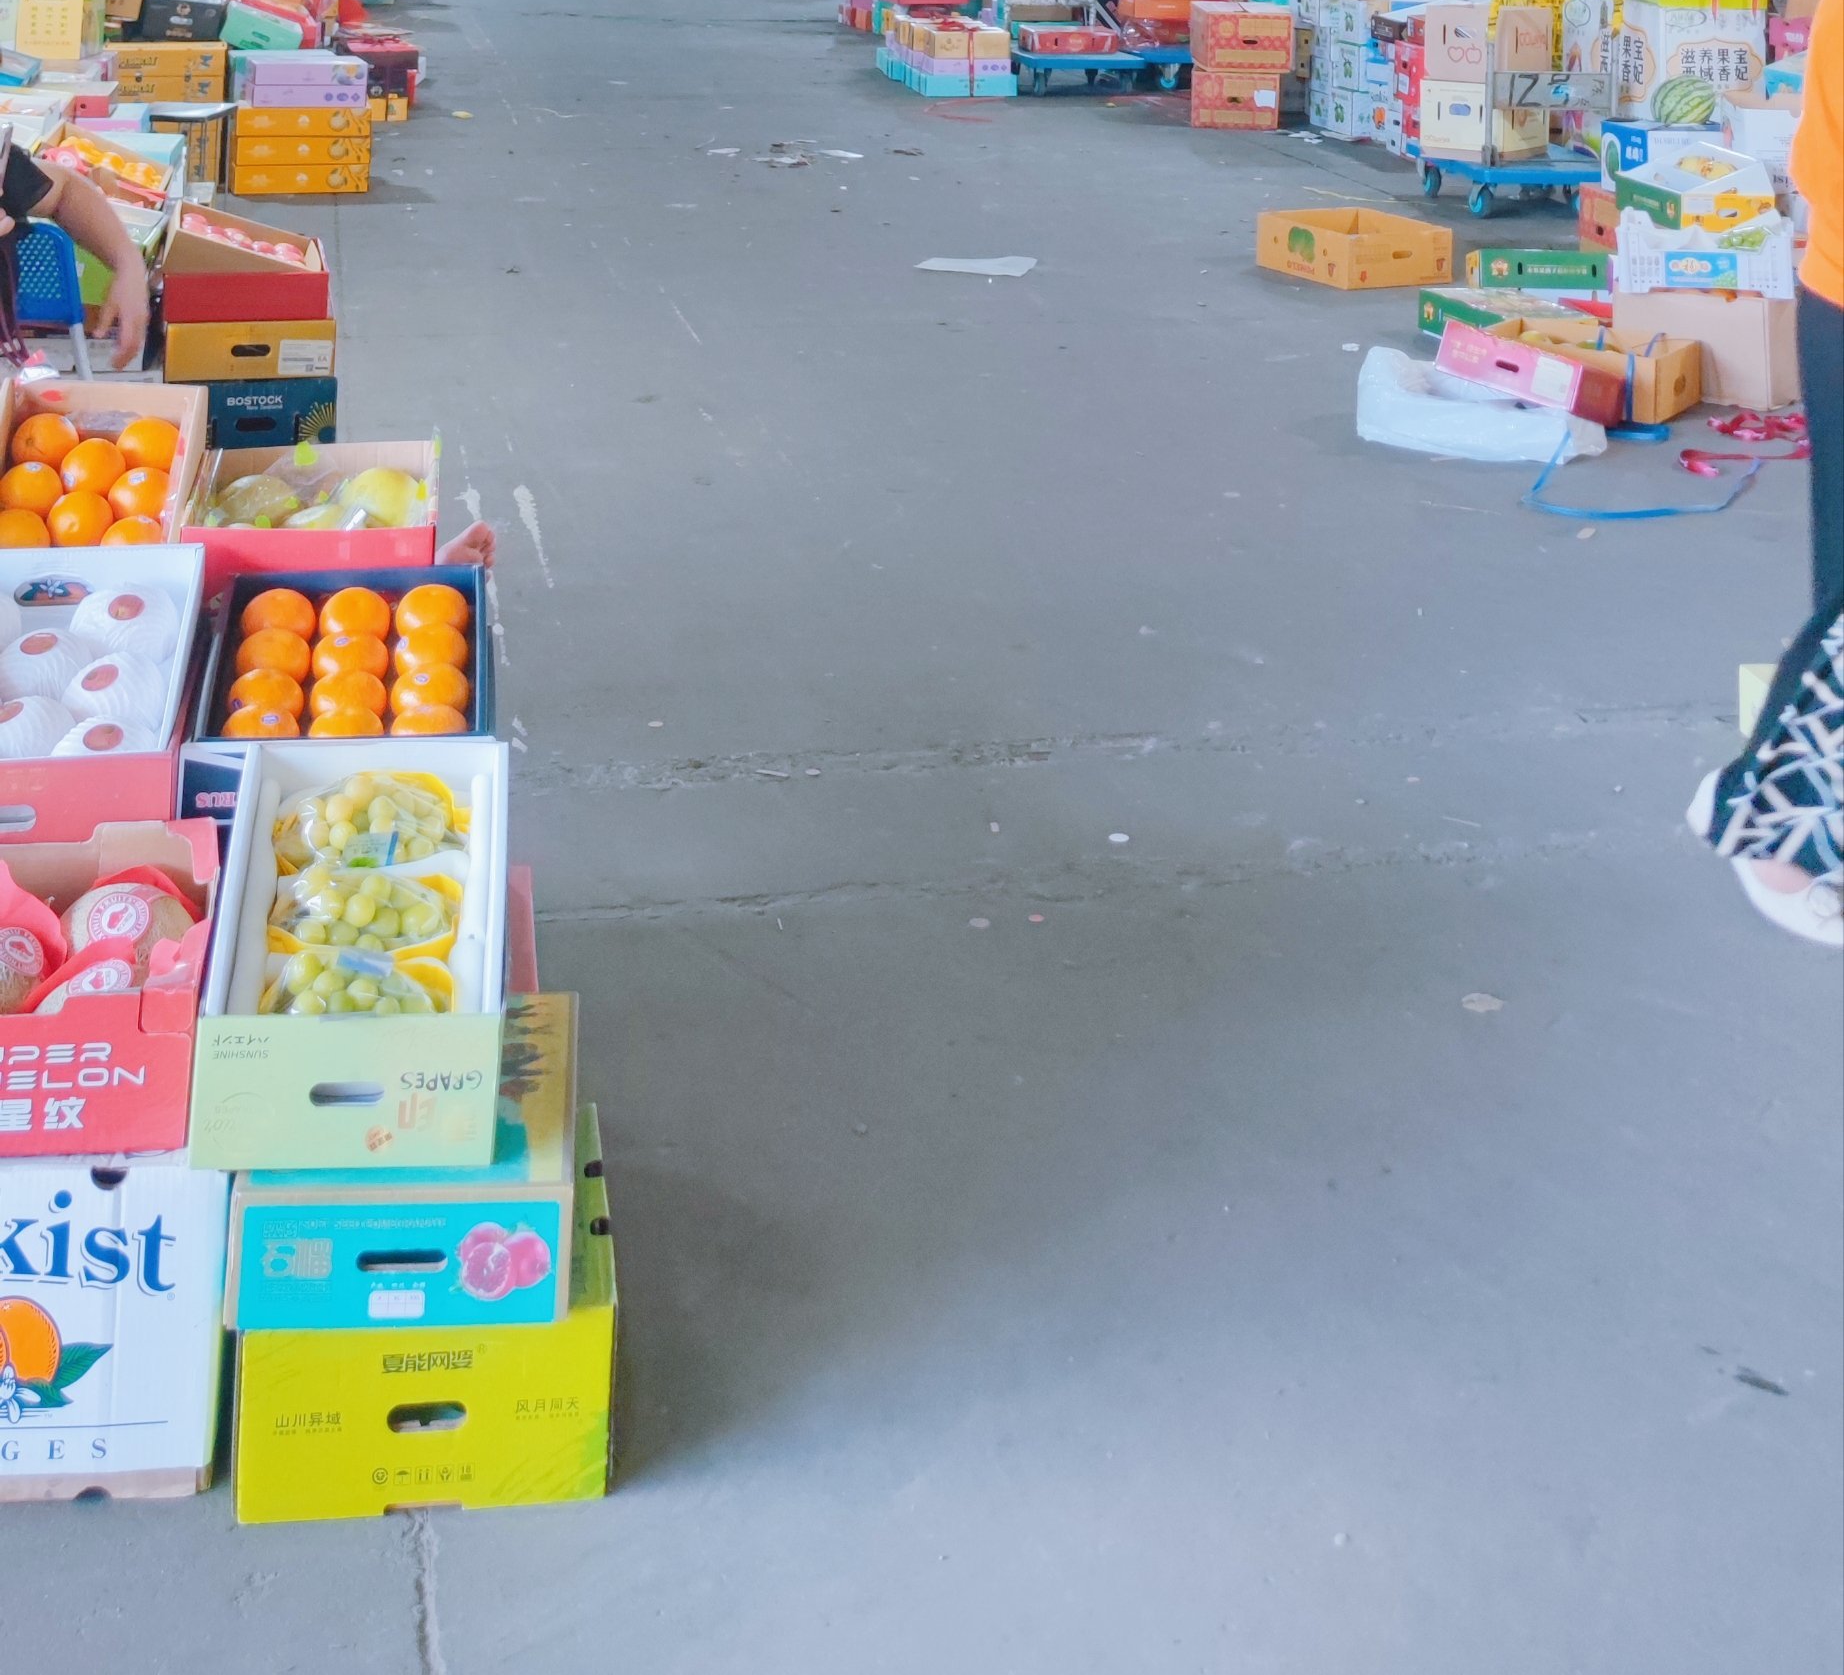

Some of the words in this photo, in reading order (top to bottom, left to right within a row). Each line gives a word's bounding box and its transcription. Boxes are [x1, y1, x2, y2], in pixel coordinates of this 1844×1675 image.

[1680, 47, 1749, 65] 滋养果宝
[1681, 64, 1749, 83] 西域香妃
[226, 395, 283, 407] BOSTOCK
[195, 791, 237, 808] RUS
[0, 1042, 113, 1065] PER
[212, 1049, 270, 1060] SUNSHINE
[0, 1065, 146, 1091] ELON
[400, 1069, 483, 1092] GRAPES
[275, 1411, 342, 1429] 山川异域
